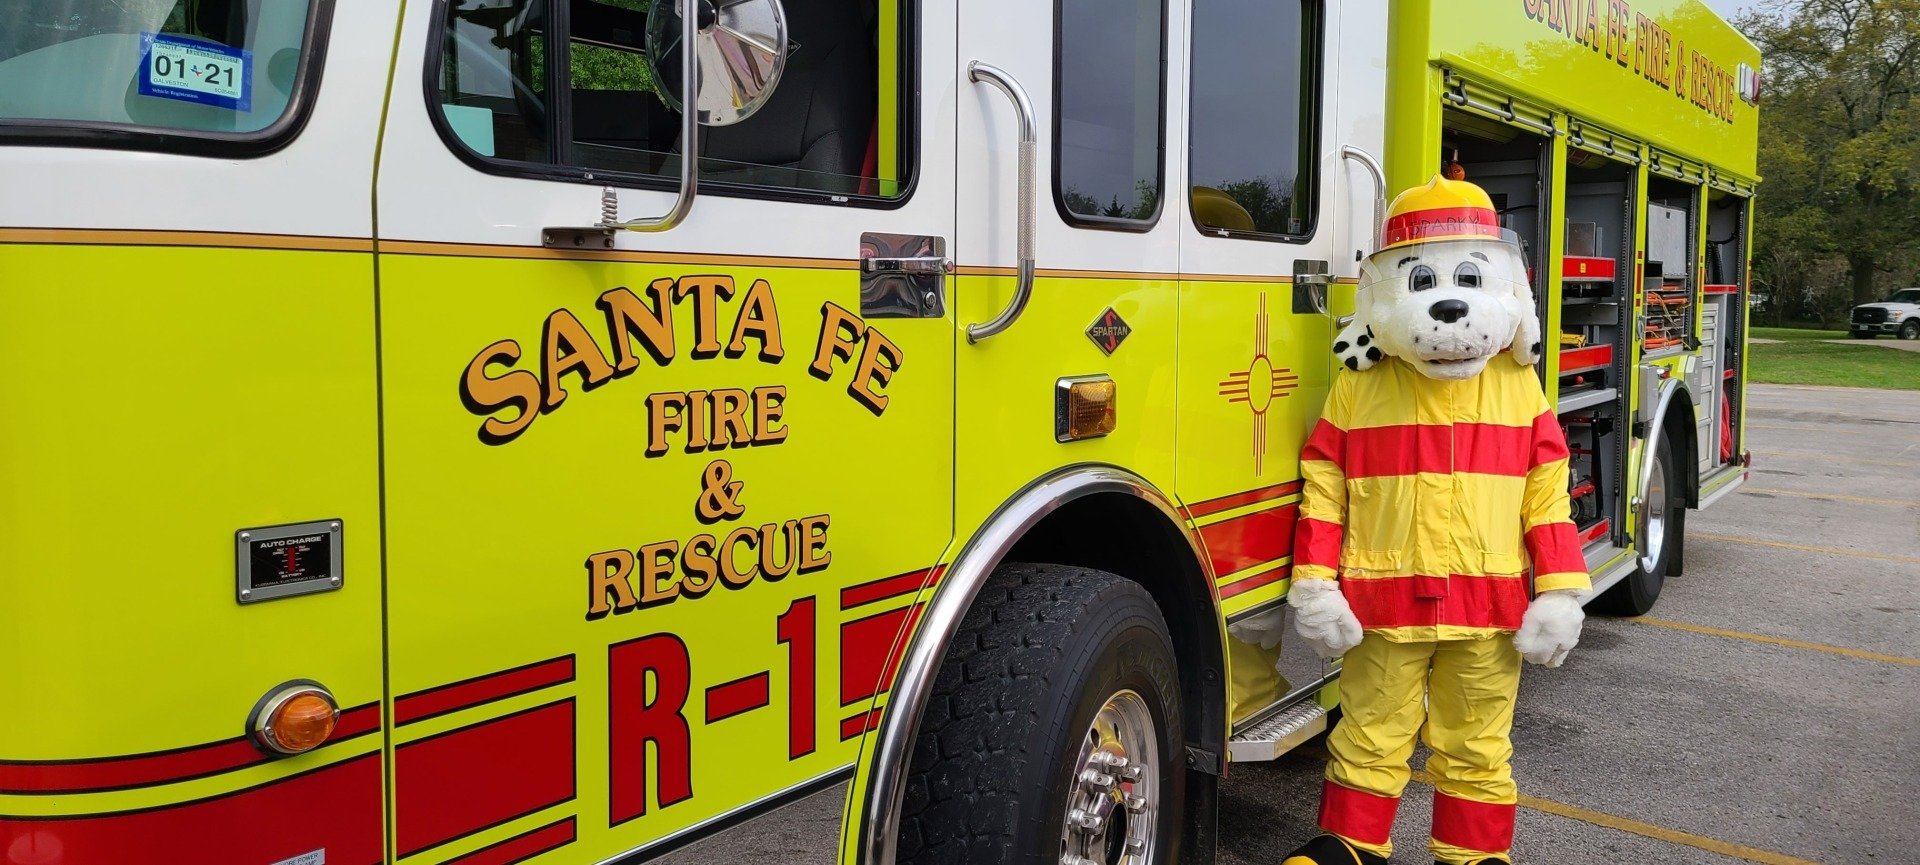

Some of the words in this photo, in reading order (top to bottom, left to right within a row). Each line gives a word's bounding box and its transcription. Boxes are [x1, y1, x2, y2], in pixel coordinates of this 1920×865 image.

[155, 55, 185, 79] 01
[204, 63, 233, 88] 21
[1524, 0, 1599, 52] NTA
[1605, 0, 1630, 68] FE
[1634, 11, 1672, 91] FIRE
[1675, 40, 1687, 100] &
[1690, 50, 1735, 125] RESCUE
[1410, 215, 1479, 237] SPARKY
[459, 274, 785, 446] SANTA
[808, 300, 904, 417] FE
[1092, 326, 1128, 337] SPARTAN
[644, 385, 788, 458] FIRE
[694, 458, 745, 525] &
[260, 540, 285, 549] AUTO
[286, 536, 322, 545] CHARGE
[585, 514, 832, 621] RESCUE
[608, 595, 816, 829] R-1
[297, 852, 319, 864] POWER
